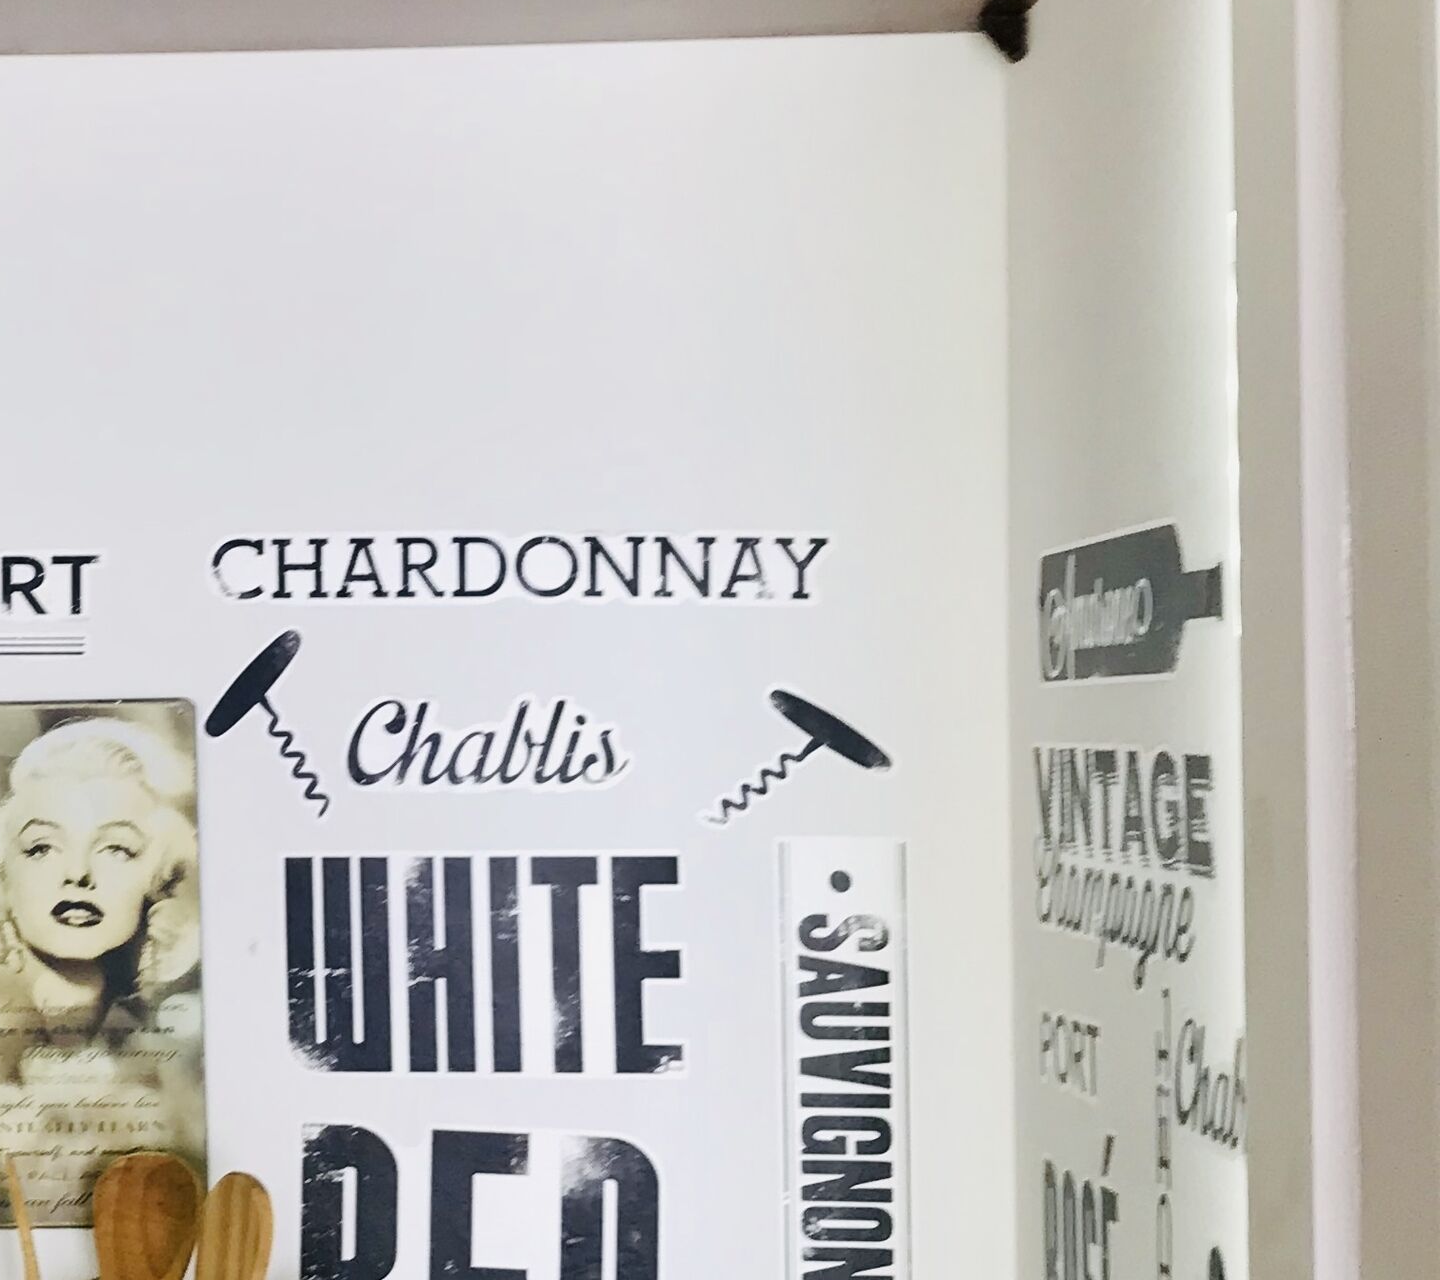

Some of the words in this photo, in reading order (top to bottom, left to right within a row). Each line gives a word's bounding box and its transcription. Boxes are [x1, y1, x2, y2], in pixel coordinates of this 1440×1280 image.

[212, 536, 829, 600] CHARDONNAY
[346, 698, 629, 786] Chablis
[1033, 747, 1216, 880] VINTAGE
[284, 856, 684, 1074] WHITE
